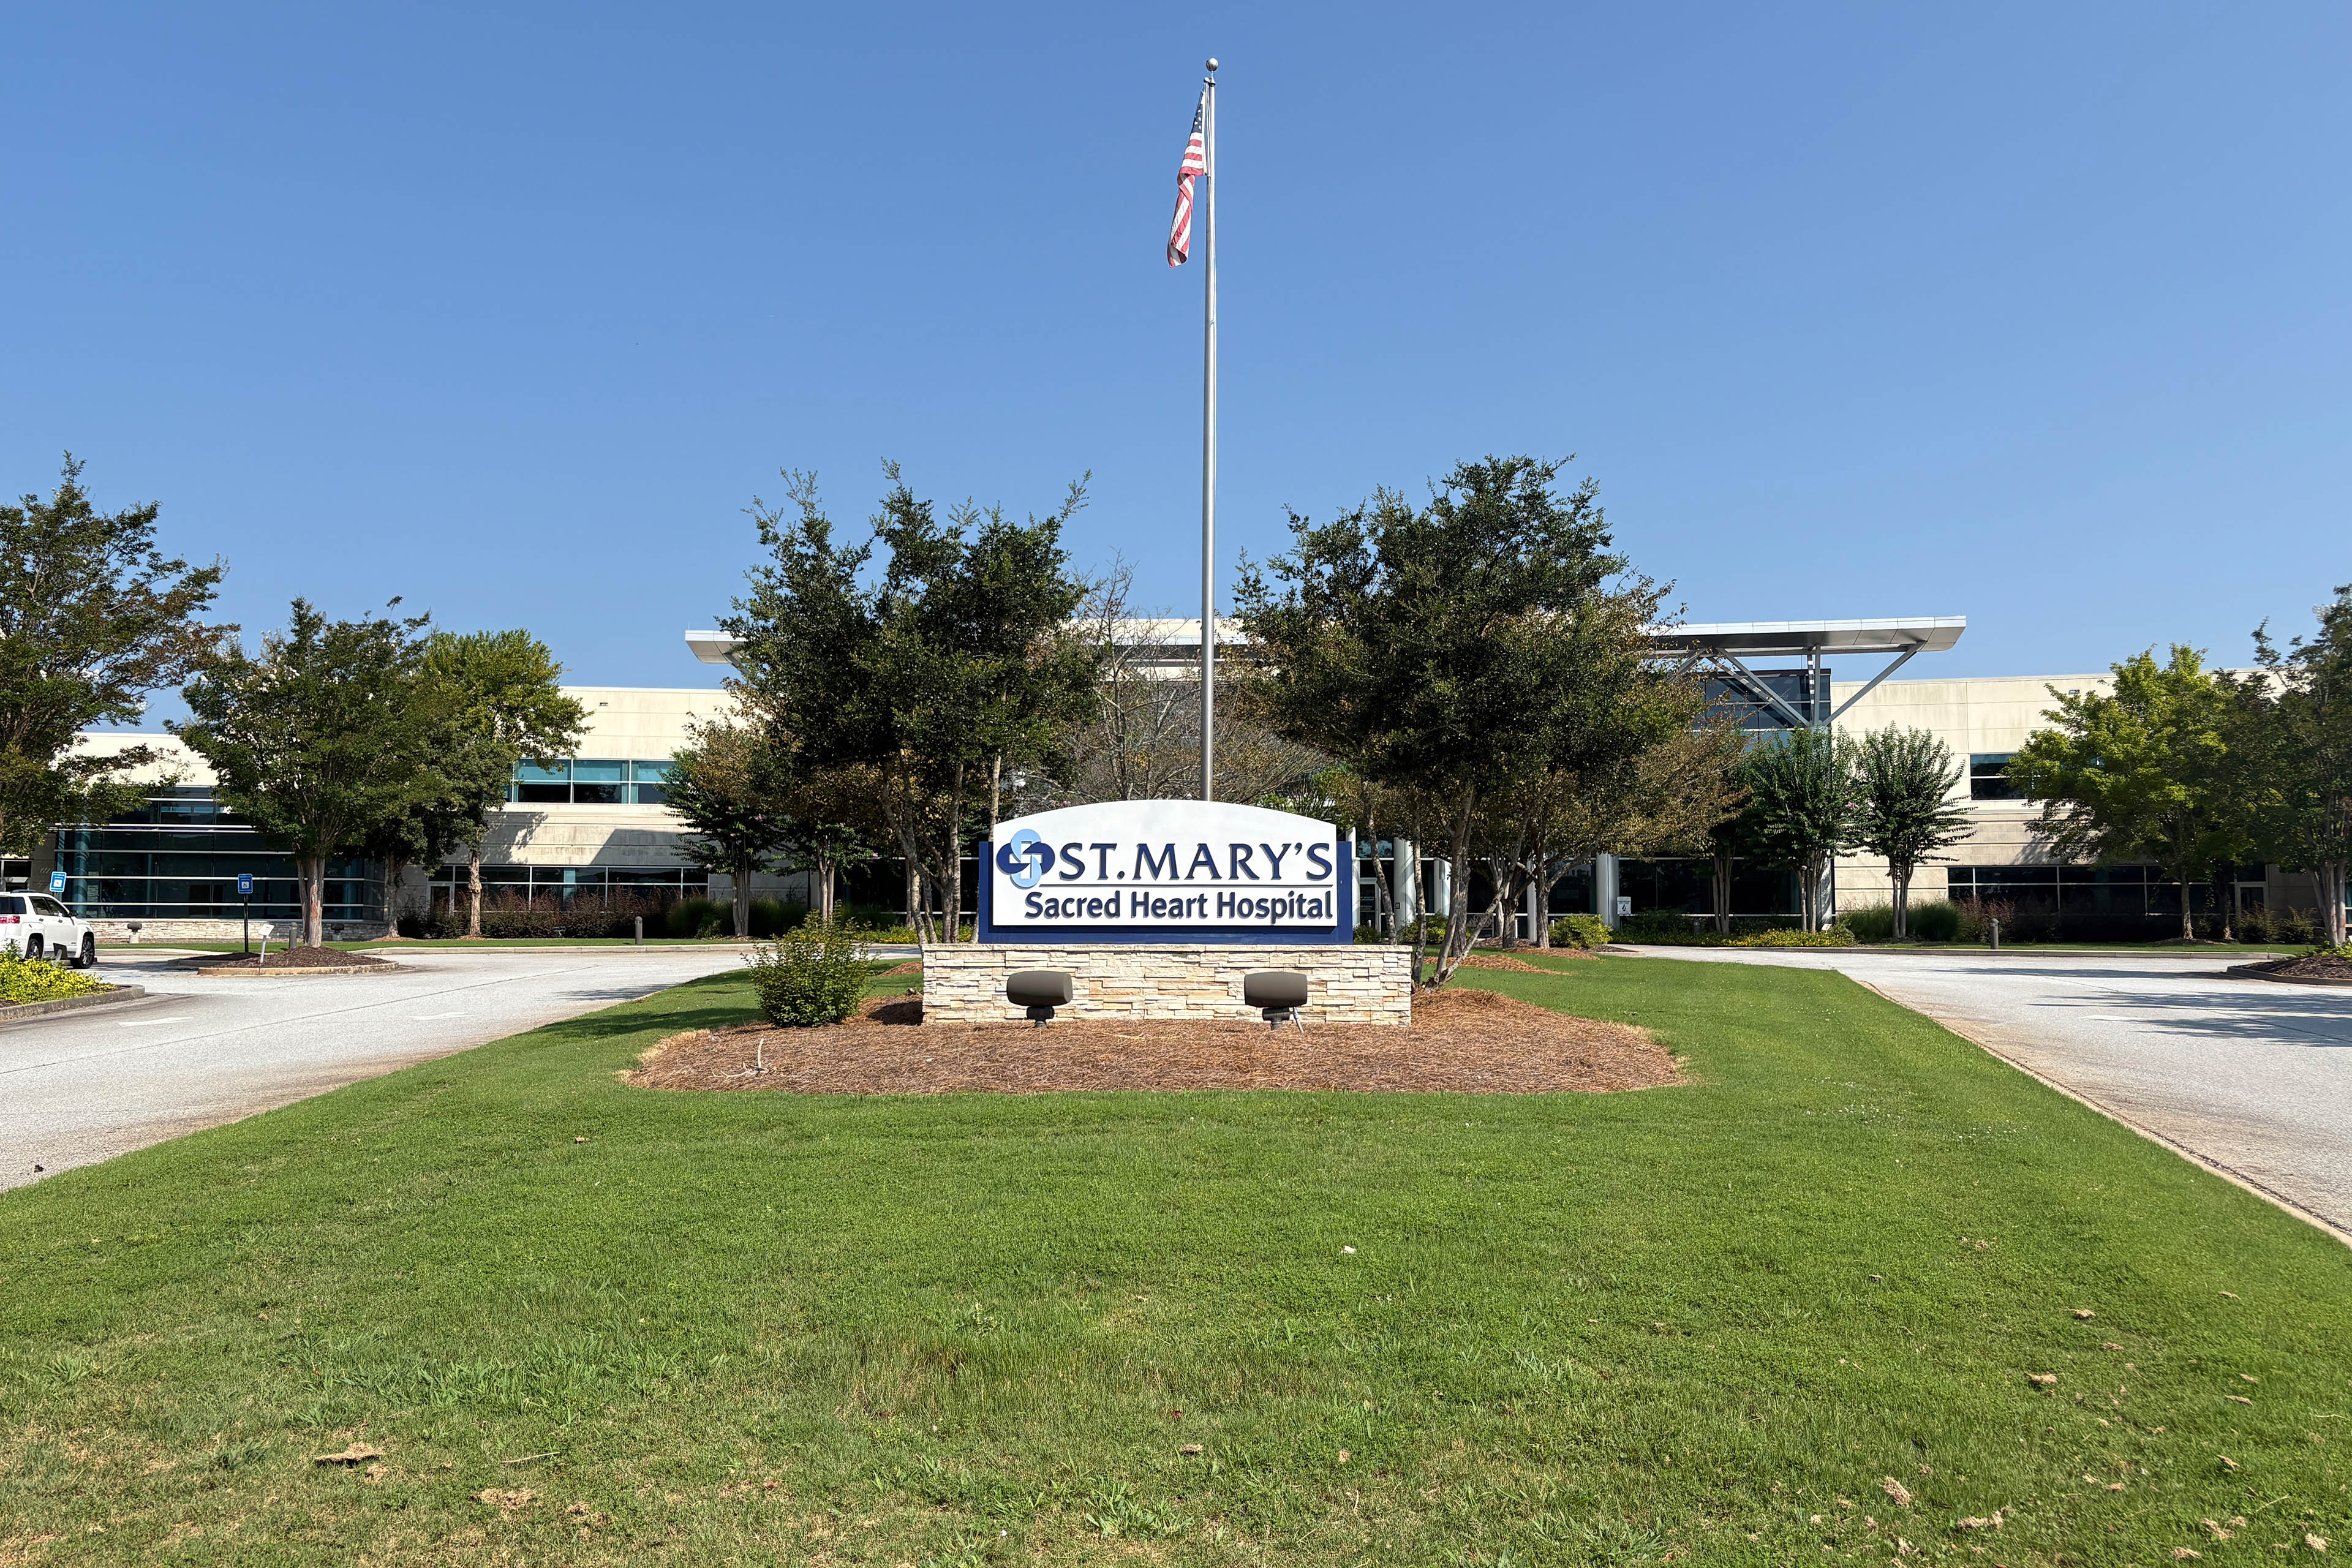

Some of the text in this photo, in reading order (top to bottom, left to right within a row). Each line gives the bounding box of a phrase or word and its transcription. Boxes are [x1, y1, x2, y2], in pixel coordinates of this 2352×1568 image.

[1025, 890, 1333, 924] Sacred Heart Hospital
